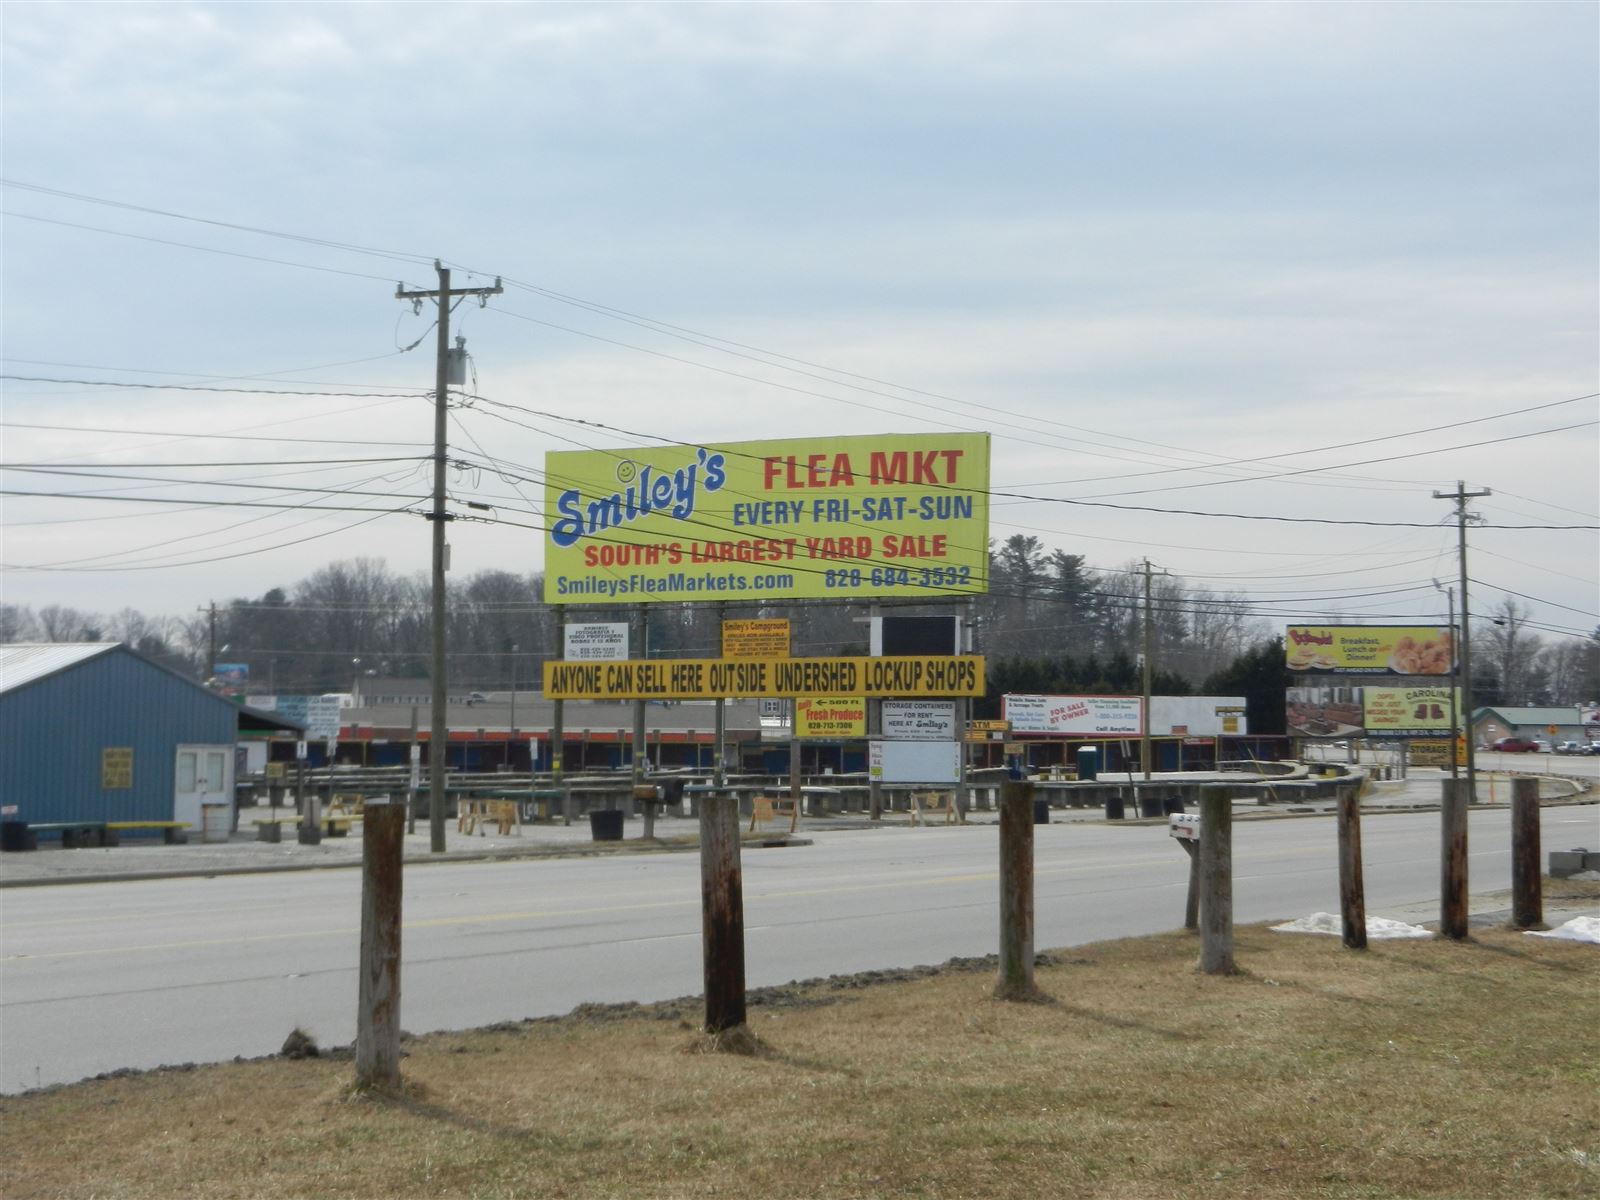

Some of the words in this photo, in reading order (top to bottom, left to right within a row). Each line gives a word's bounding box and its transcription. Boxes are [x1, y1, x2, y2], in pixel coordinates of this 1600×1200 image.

[763, 453, 855, 490] FLEA
[869, 450, 964, 486] MKT
[551, 447, 726, 547] Smiley's
[733, 500, 804, 526] EVERY
[813, 495, 973, 523] FRI-SAT-SUN
[584, 541, 683, 568] SOUTH'S
[691, 537, 797, 564] LARGEST
[805, 536, 873, 561] YARD
[882, 534, 947, 559] SALE
[557, 573, 794, 597] SmileysFleaMarkets.com
[724, 622, 749, 632] Smiley's
[750, 621, 788, 632] Campground
[551, 665, 602, 694] ANYONE
[606, 664, 633, 694] CAN
[636, 664, 667, 693] SELL
[671, 664, 703, 693] HERE
[710, 663, 766, 692] OUTSIDE
[775, 661, 857, 692] UNDERSHED
[864, 660, 922, 692] LOCKUP
[926, 660, 975, 691] SHOPS
[806, 708, 828, 720] Fresh
[830, 708, 864, 720] Produce
[1050, 707, 1065, 717] FOR
[1067, 701, 1085, 711] SALE
[1061, 708, 1088, 721] OWNER
[915, 719, 948, 730] Smiley's
[1410, 745, 1447, 753] STORAGE
